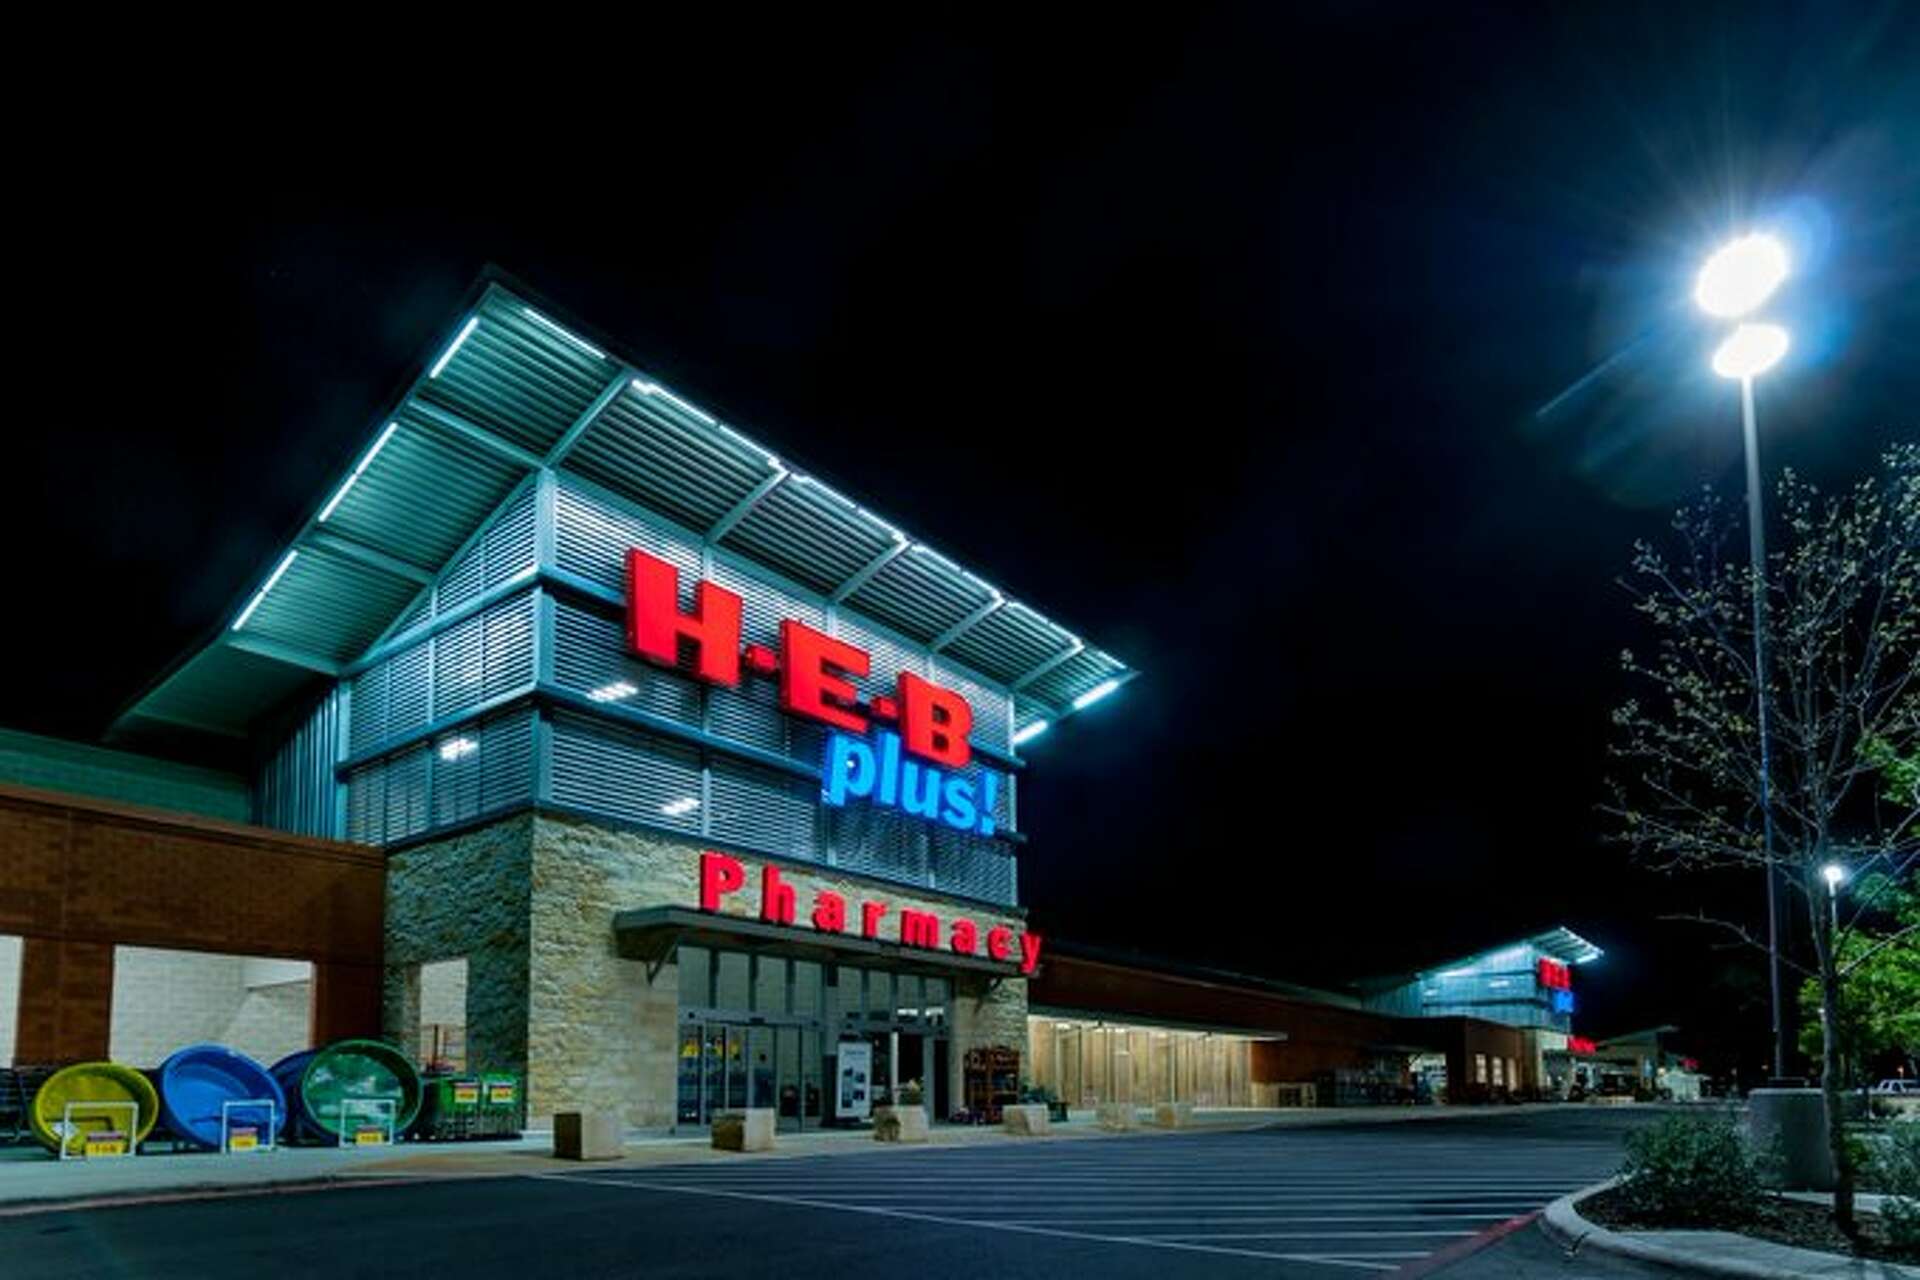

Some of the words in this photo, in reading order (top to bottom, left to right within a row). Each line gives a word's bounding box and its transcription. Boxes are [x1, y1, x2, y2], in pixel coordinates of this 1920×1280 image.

[627, 547, 974, 768] H-E-B
[822, 727, 999, 838] plus!
[701, 850, 1042, 974] Pharmacy
